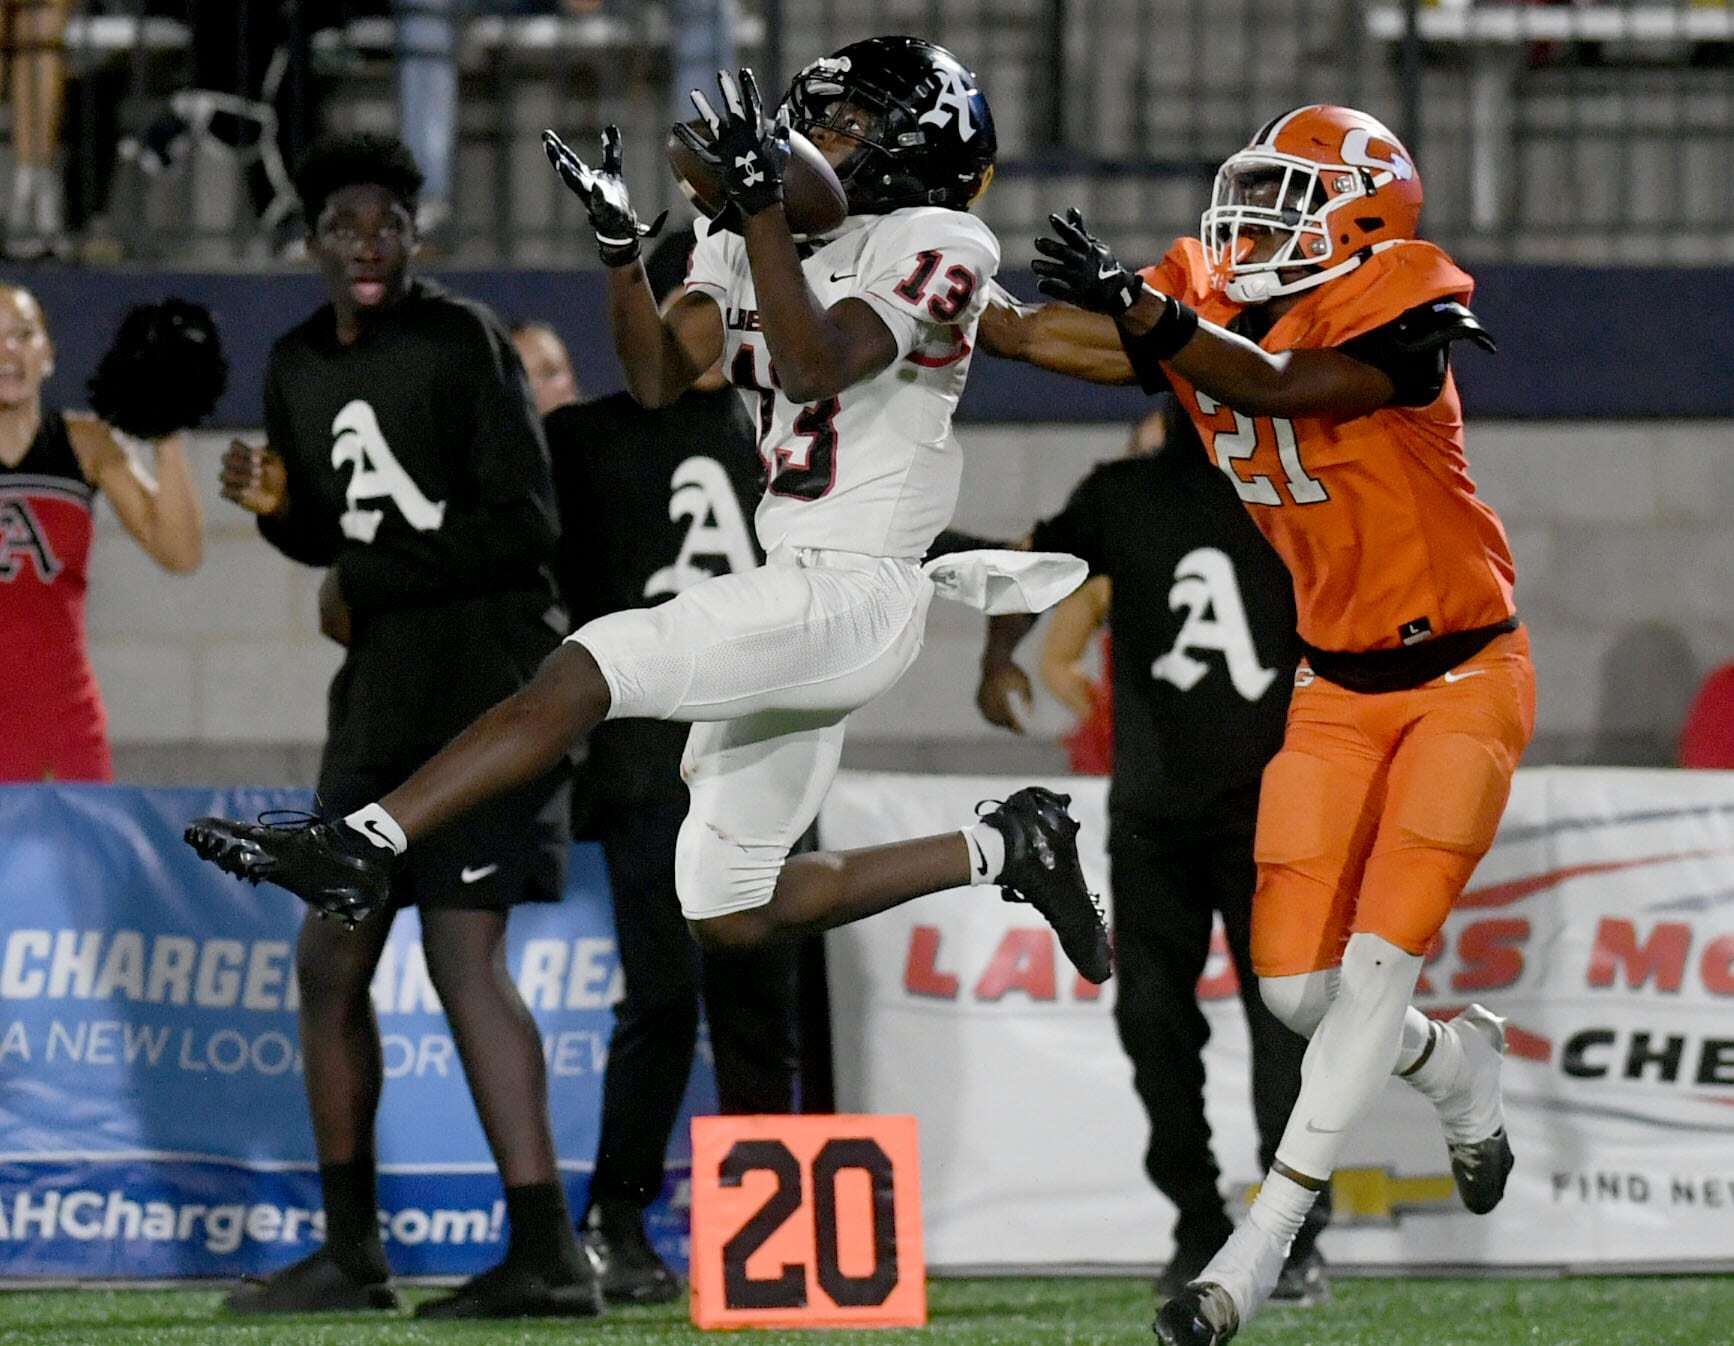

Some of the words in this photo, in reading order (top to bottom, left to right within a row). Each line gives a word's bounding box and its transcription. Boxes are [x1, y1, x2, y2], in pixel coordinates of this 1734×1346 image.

[893, 249, 976, 323] 13
[331, 399, 447, 545] A
[731, 343, 840, 502] 13
[1195, 389, 1331, 507] 21
[643, 455, 758, 598] A
[1151, 547, 1279, 701] A
[0, 928, 299, 1012] CHARGE
[0, 1020, 31, 1063] A
[46, 1020, 171, 1066] NEW
[178, 1026, 305, 1076] LOO
[382, 1034, 453, 1077] OR
[1562, 1028, 1734, 1086] CHE
[718, 1138, 899, 1310] 20
[1551, 1171, 1651, 1204] FIND
[1671, 1178, 1734, 1208] NE
